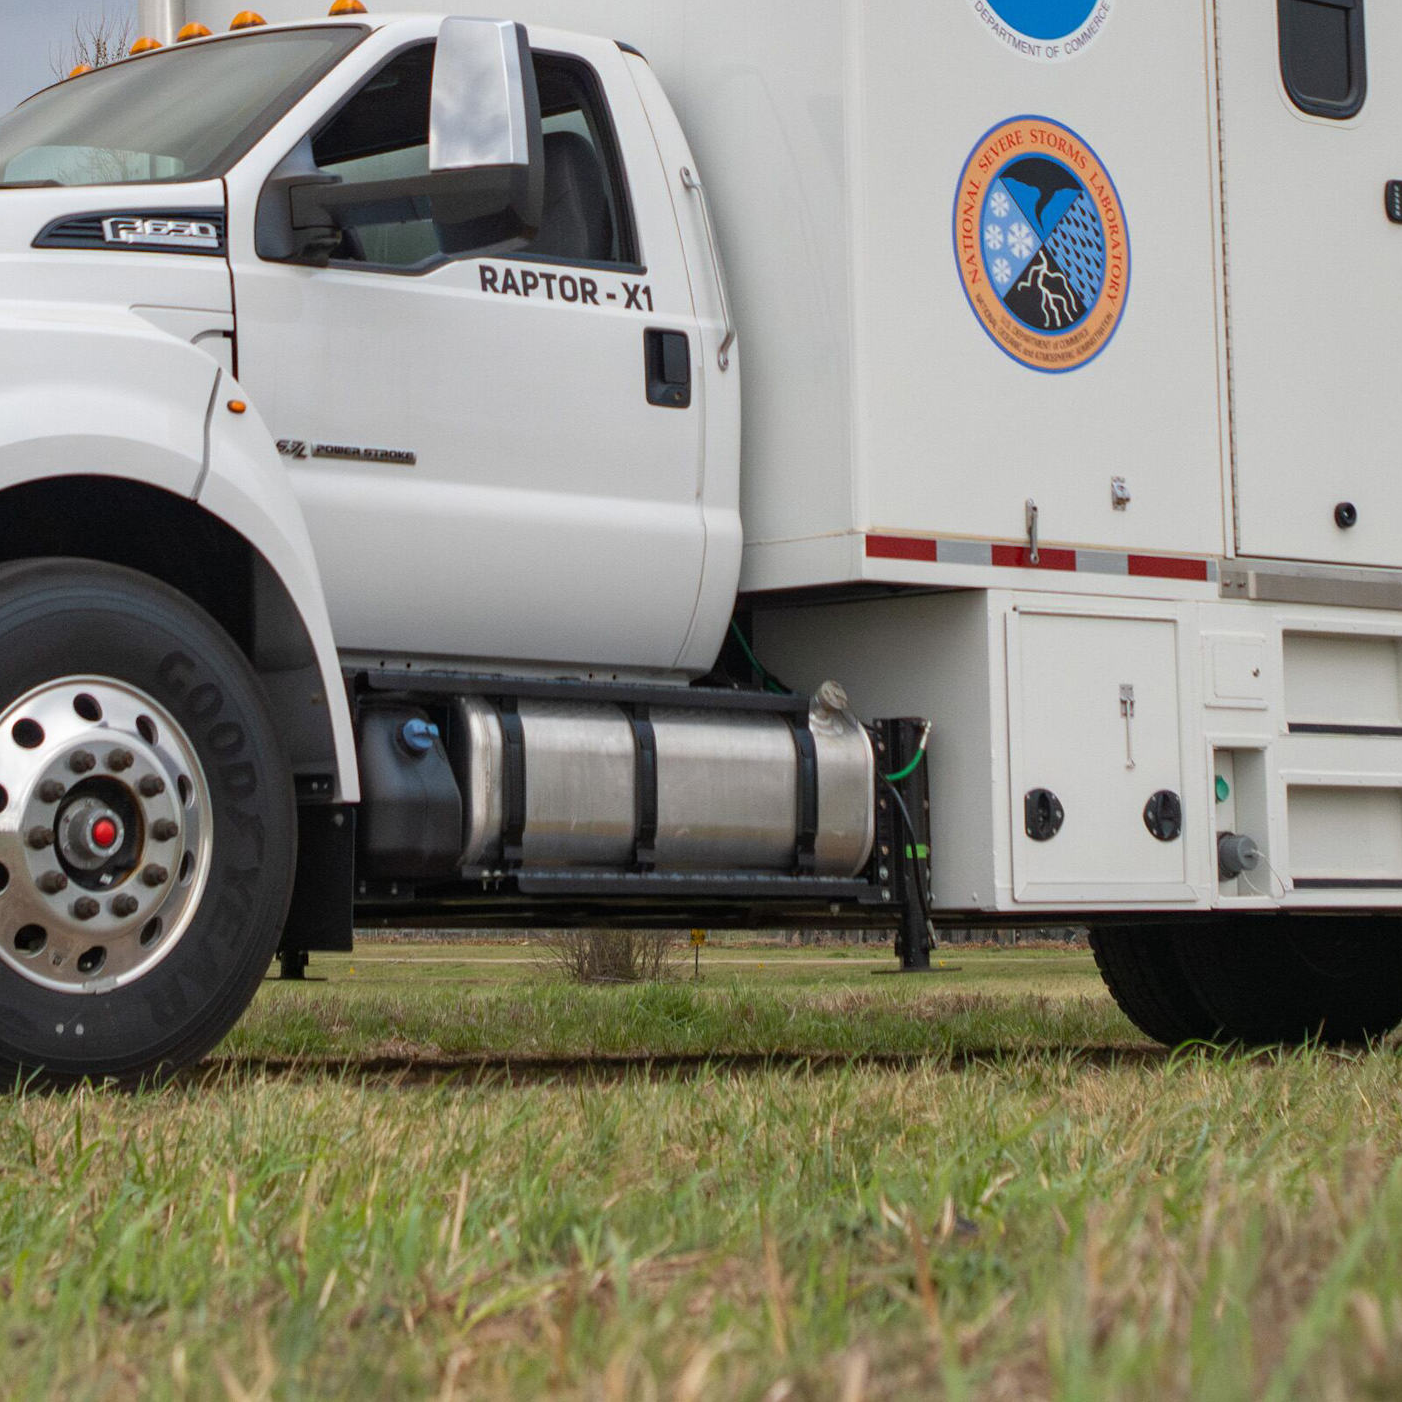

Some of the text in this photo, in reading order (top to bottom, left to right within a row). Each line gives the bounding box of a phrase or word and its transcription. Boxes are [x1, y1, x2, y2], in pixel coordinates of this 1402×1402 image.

[974, 0, 1042, 58] DEPARTMENT
[1045, 45, 1061, 59] OF
[962, 128, 1122, 306] NATIONAL SEVERE STORMS LABORATORY
[479, 264, 601, 306] RAPTOR
[621, 281, 654, 312] X1
[316, 443, 361, 457] POWER
[364, 447, 415, 461] STROKE
